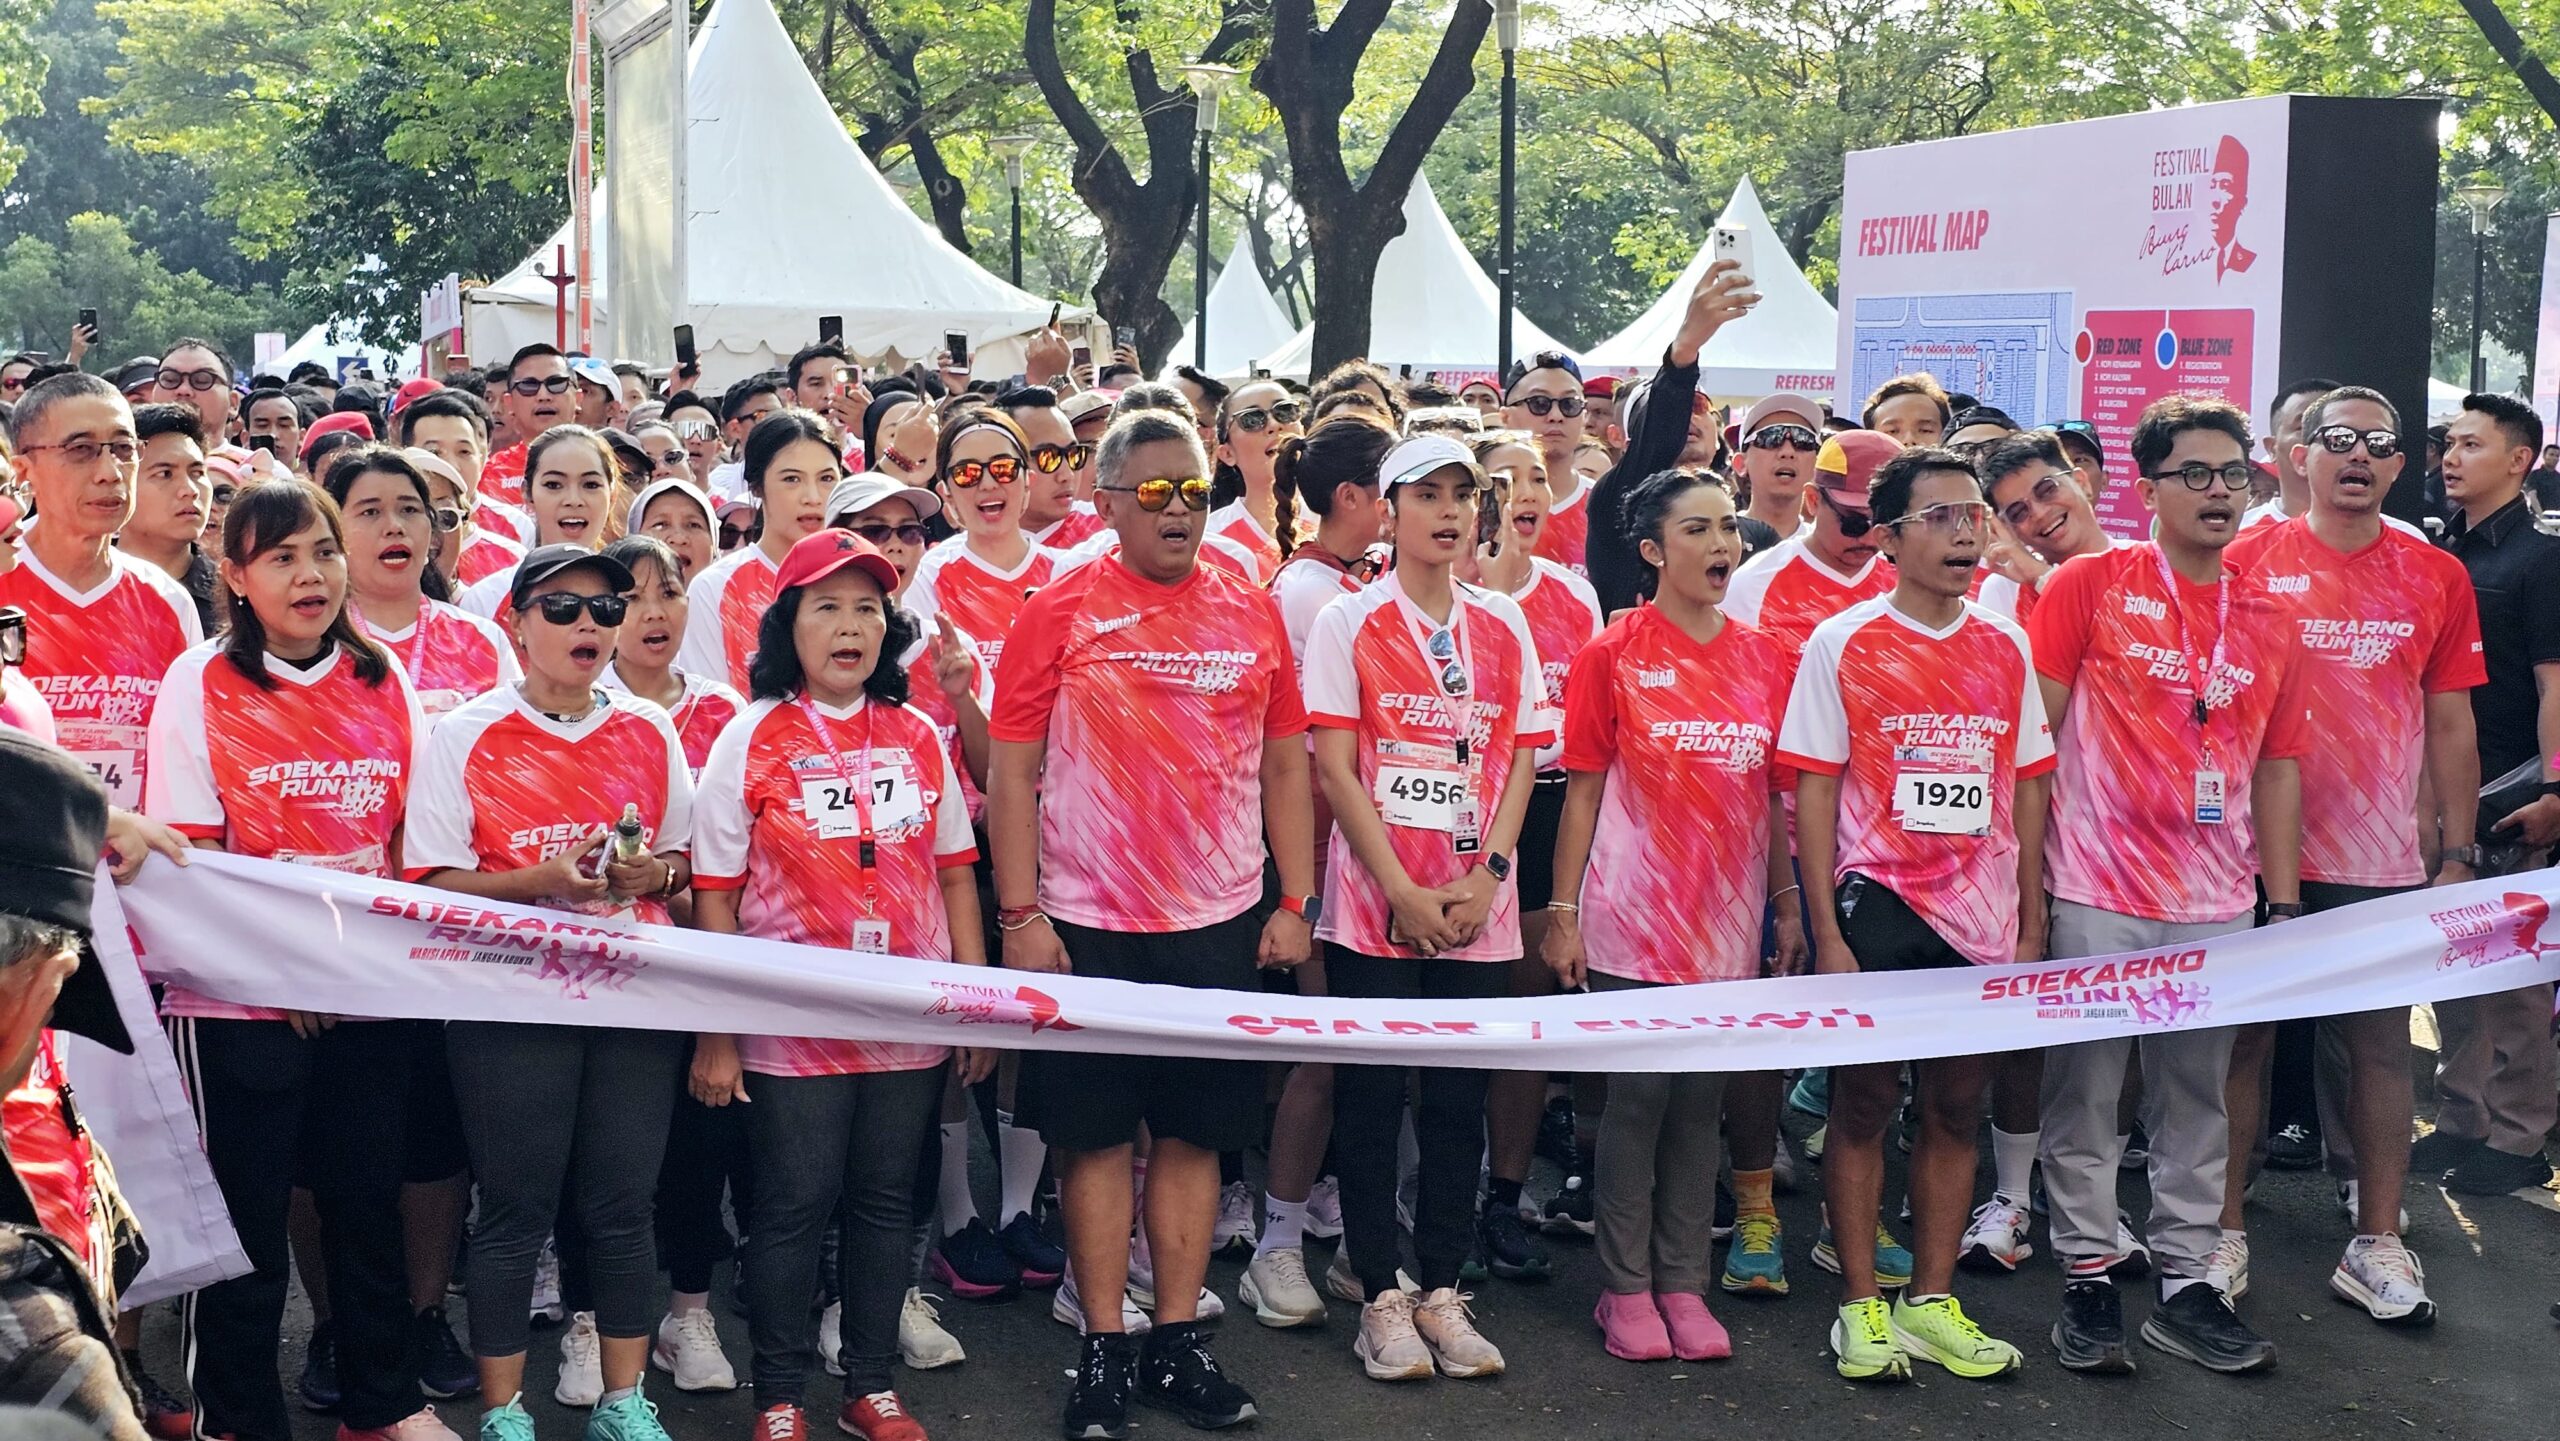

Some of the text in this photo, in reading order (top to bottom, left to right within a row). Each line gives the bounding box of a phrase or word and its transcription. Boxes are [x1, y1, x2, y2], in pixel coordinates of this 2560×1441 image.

[2153, 147, 2209, 177] FESTIVAL
[2152, 182, 2192, 211] BULAN
[581, 216, 590, 251] DATANG
[1858, 209, 1990, 257] FESTIVAL MAP
[2139, 224, 2189, 260] Bung
[2096, 338, 2142, 355] RED ZONE
[2180, 338, 2233, 356] BLUE ZONE
[1775, 375, 1835, 391] REFRESH
[1132, 660, 1197, 675] RUN
[1880, 713, 2010, 735] SOEKARNO
[1674, 736, 1732, 752] RUN
[1904, 730, 1958, 746] RUN
[246, 758, 401, 789] SOEKARNO
[280, 777, 341, 799] RUN
[1390, 775, 1464, 805] 4956
[1913, 781, 1982, 810] 1920
[2430, 901, 2501, 926] FESTIVAL
[427, 925, 547, 951] RUN
[2443, 919, 2493, 939] BULAN
[408, 947, 438, 961] WARISI
[471, 950, 502, 964] JANGAN
[502, 953, 534, 966] ABUNYA
[1981, 949, 2207, 1000] SOEKARNO
[2037, 986, 2120, 1005] RUN
[2083, 1008, 2105, 1018] JANGAN
